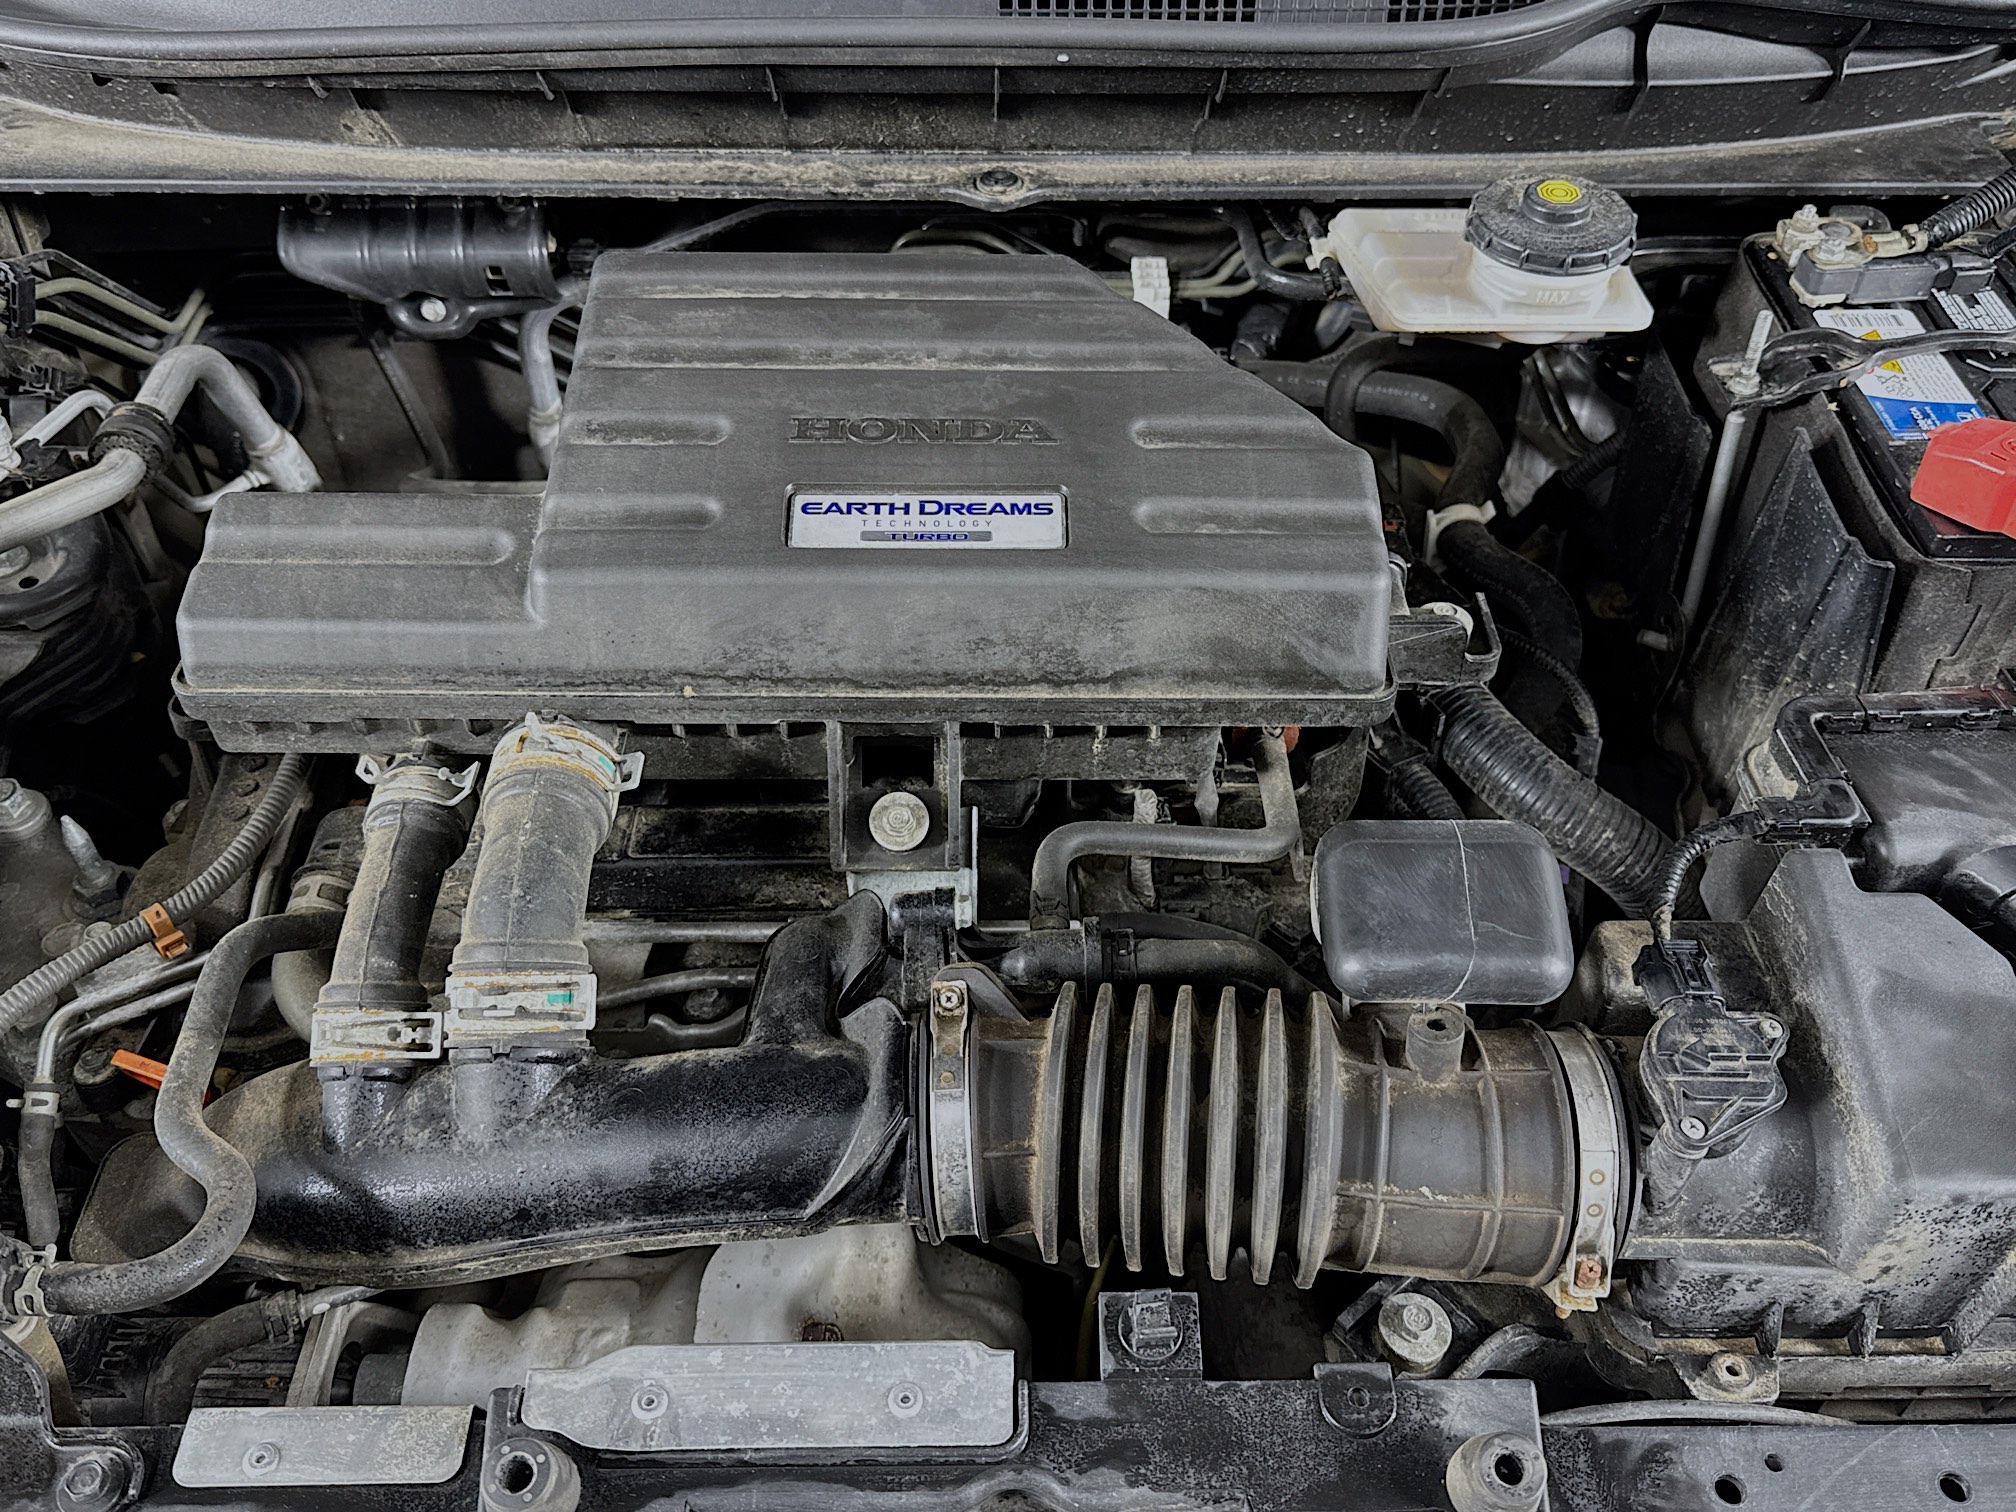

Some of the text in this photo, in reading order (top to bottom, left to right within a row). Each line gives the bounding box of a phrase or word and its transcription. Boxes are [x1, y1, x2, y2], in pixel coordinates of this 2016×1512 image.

[1536, 289, 1570, 305] MAX
[788, 417, 1060, 444] HONDA
[801, 502, 910, 515] EARTH
[862, 519, 993, 528] TECHNOLOGY
[886, 532, 969, 541] TURBO
